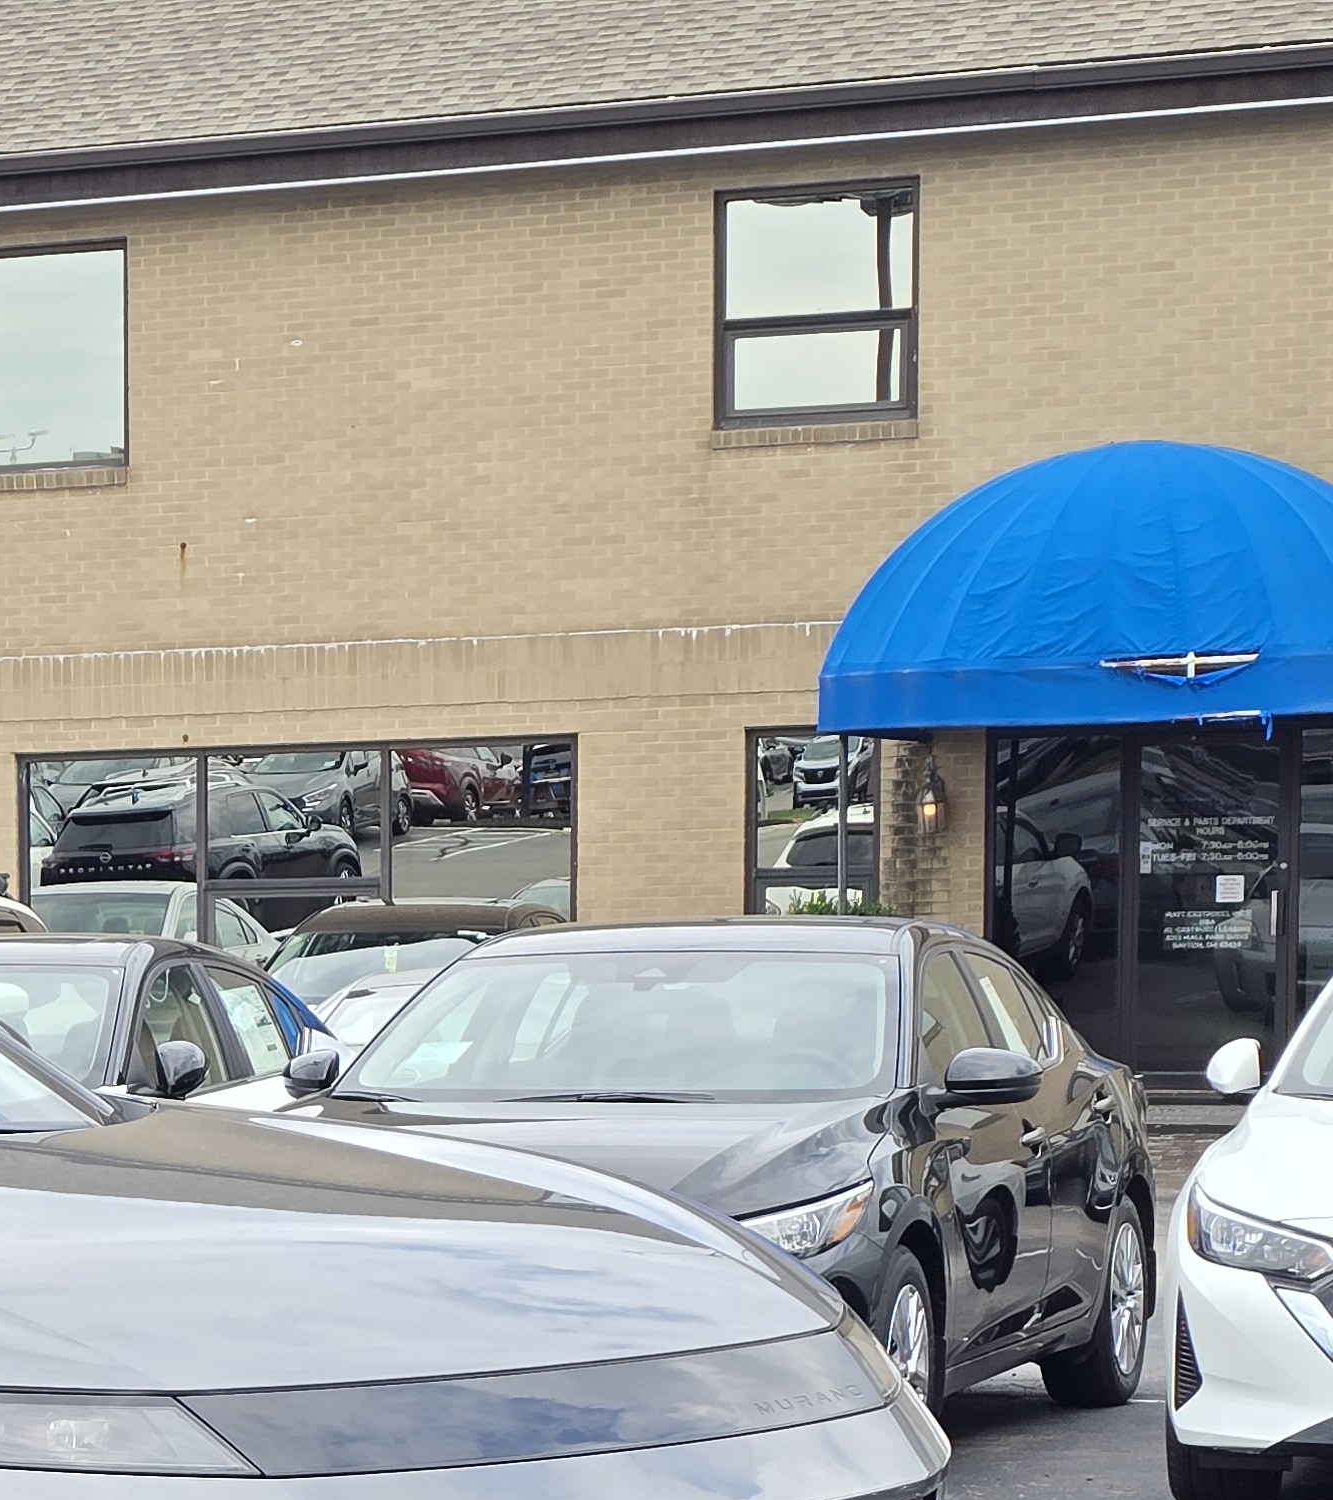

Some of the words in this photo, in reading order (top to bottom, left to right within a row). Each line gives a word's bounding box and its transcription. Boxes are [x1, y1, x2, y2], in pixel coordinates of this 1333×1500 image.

[1147, 817, 1181, 827] SERVICE
[1193, 817, 1219, 826] PARTS
[1221, 815, 1275, 826] DEPARTMENT
[1196, 826, 1225, 836] HOURS
[753, 1384, 864, 1416] MURANO
